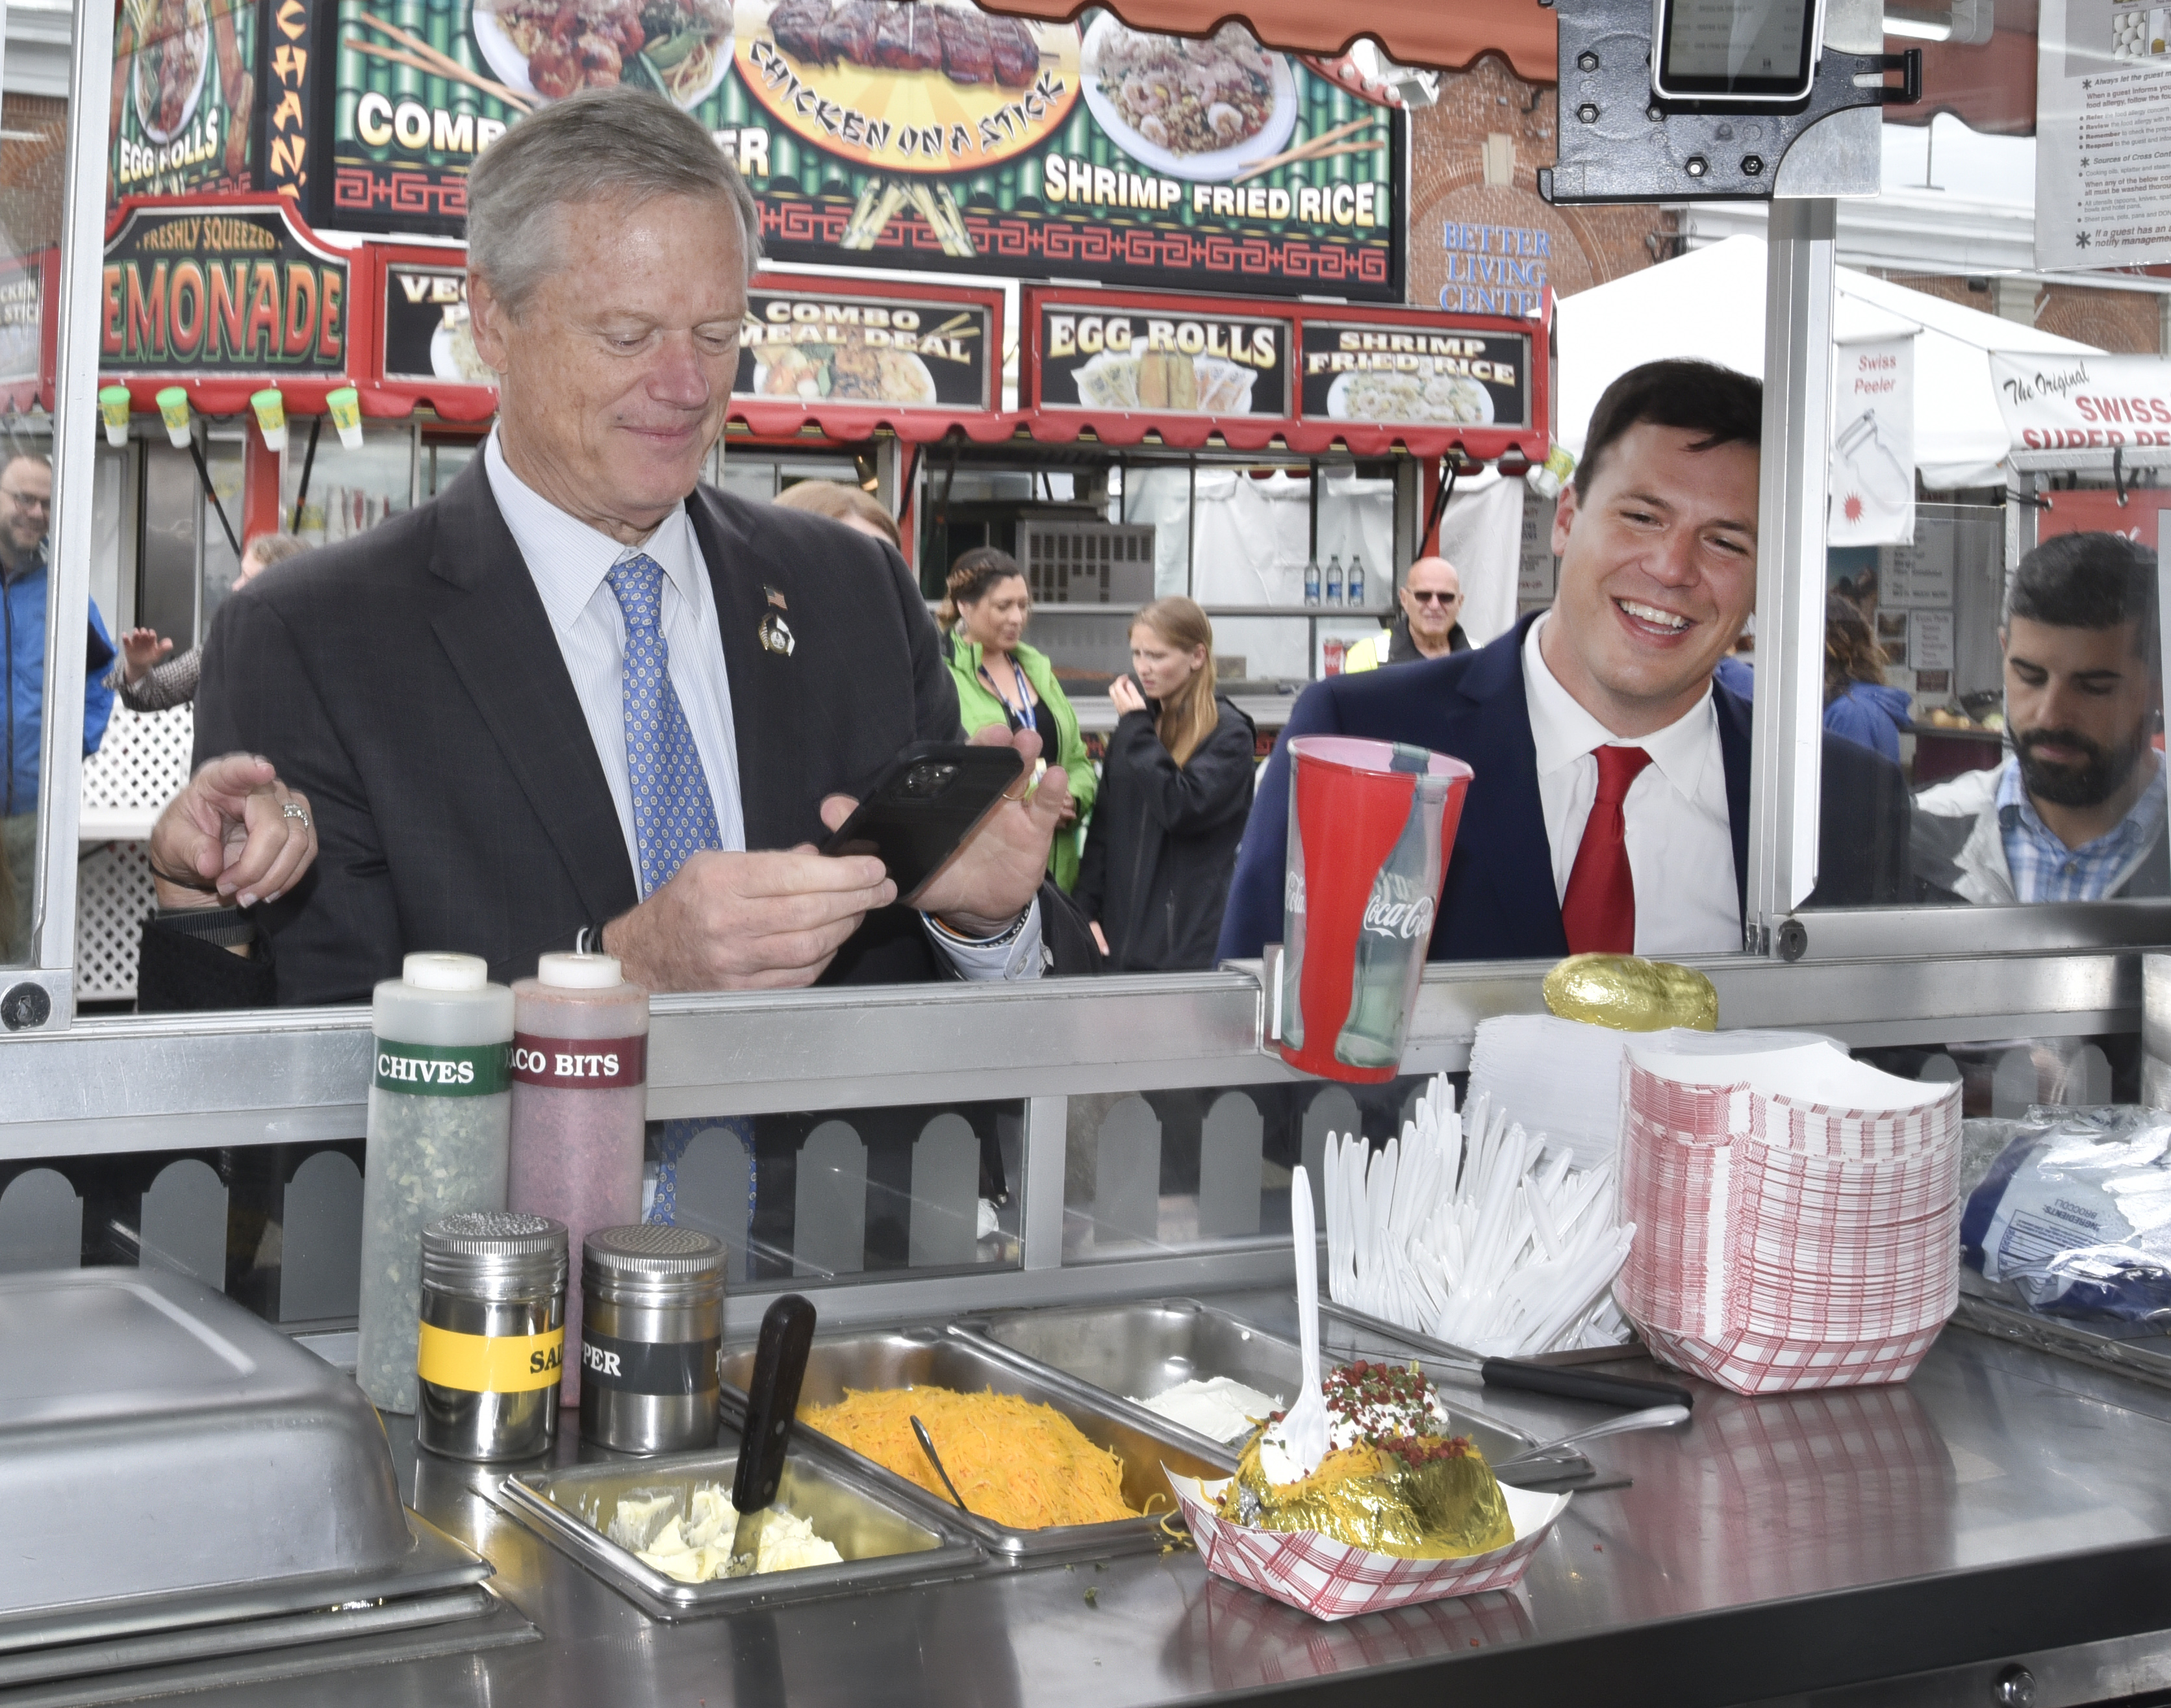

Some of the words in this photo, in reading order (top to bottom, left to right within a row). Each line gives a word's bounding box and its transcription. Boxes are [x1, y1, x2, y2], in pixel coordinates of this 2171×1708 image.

[2094, 77, 2118, 86] Always
[2143, 71, 2163, 81] guest
[2112, 89, 2131, 98] guest
[2133, 86, 2157, 95] informs
[749, 40, 892, 151] CHICKEN
[897, 122, 945, 158] ON
[948, 123, 973, 157] A
[978, 70, 1067, 154] STICK
[2127, 96, 2147, 104] follow
[2086, 131, 2120, 140] Remember
[2086, 141, 2113, 149] Respond
[120, 136, 155, 185] EGG
[1044, 153, 1182, 212] SHRIMP
[1193, 183, 1291, 220] FRIED
[1299, 181, 1375, 227] RICE
[143, 216, 201, 251] FRESHLY
[203, 216, 275, 253] SQUEEZED
[1442, 220, 1551, 258] BETTER
[2095, 229, 2102, 238] If
[2110, 227, 2135, 238] guest
[2137, 226, 2153, 235] has
[2095, 237, 2120, 248] notify
[1447, 252, 1547, 287] LIVING
[99, 259, 342, 364] EMONADE
[765, 301, 920, 331] COMBO
[739, 323, 847, 347] MEAL
[864, 327, 972, 366] DEAL
[1047, 314, 1134, 359] EGG
[1147, 318, 1278, 370] ROLLS
[1338, 330, 1487, 357] SHRIMP
[1304, 351, 1421, 376] FRIED
[1430, 353, 1516, 387] RICE
[1858, 353, 1897, 372] Swiss
[1854, 376, 1896, 395] Peeler
[2003, 377, 2034, 407] The
[2035, 359, 2090, 400] Original
[2075, 394, 2171, 424] SWISS
[377, 1052, 475, 1085] CHIVES
[554, 1052, 620, 1077] BITS
[2055, 1198, 2098, 1219] BROCCOLI
[581, 1341, 622, 1377] PER
